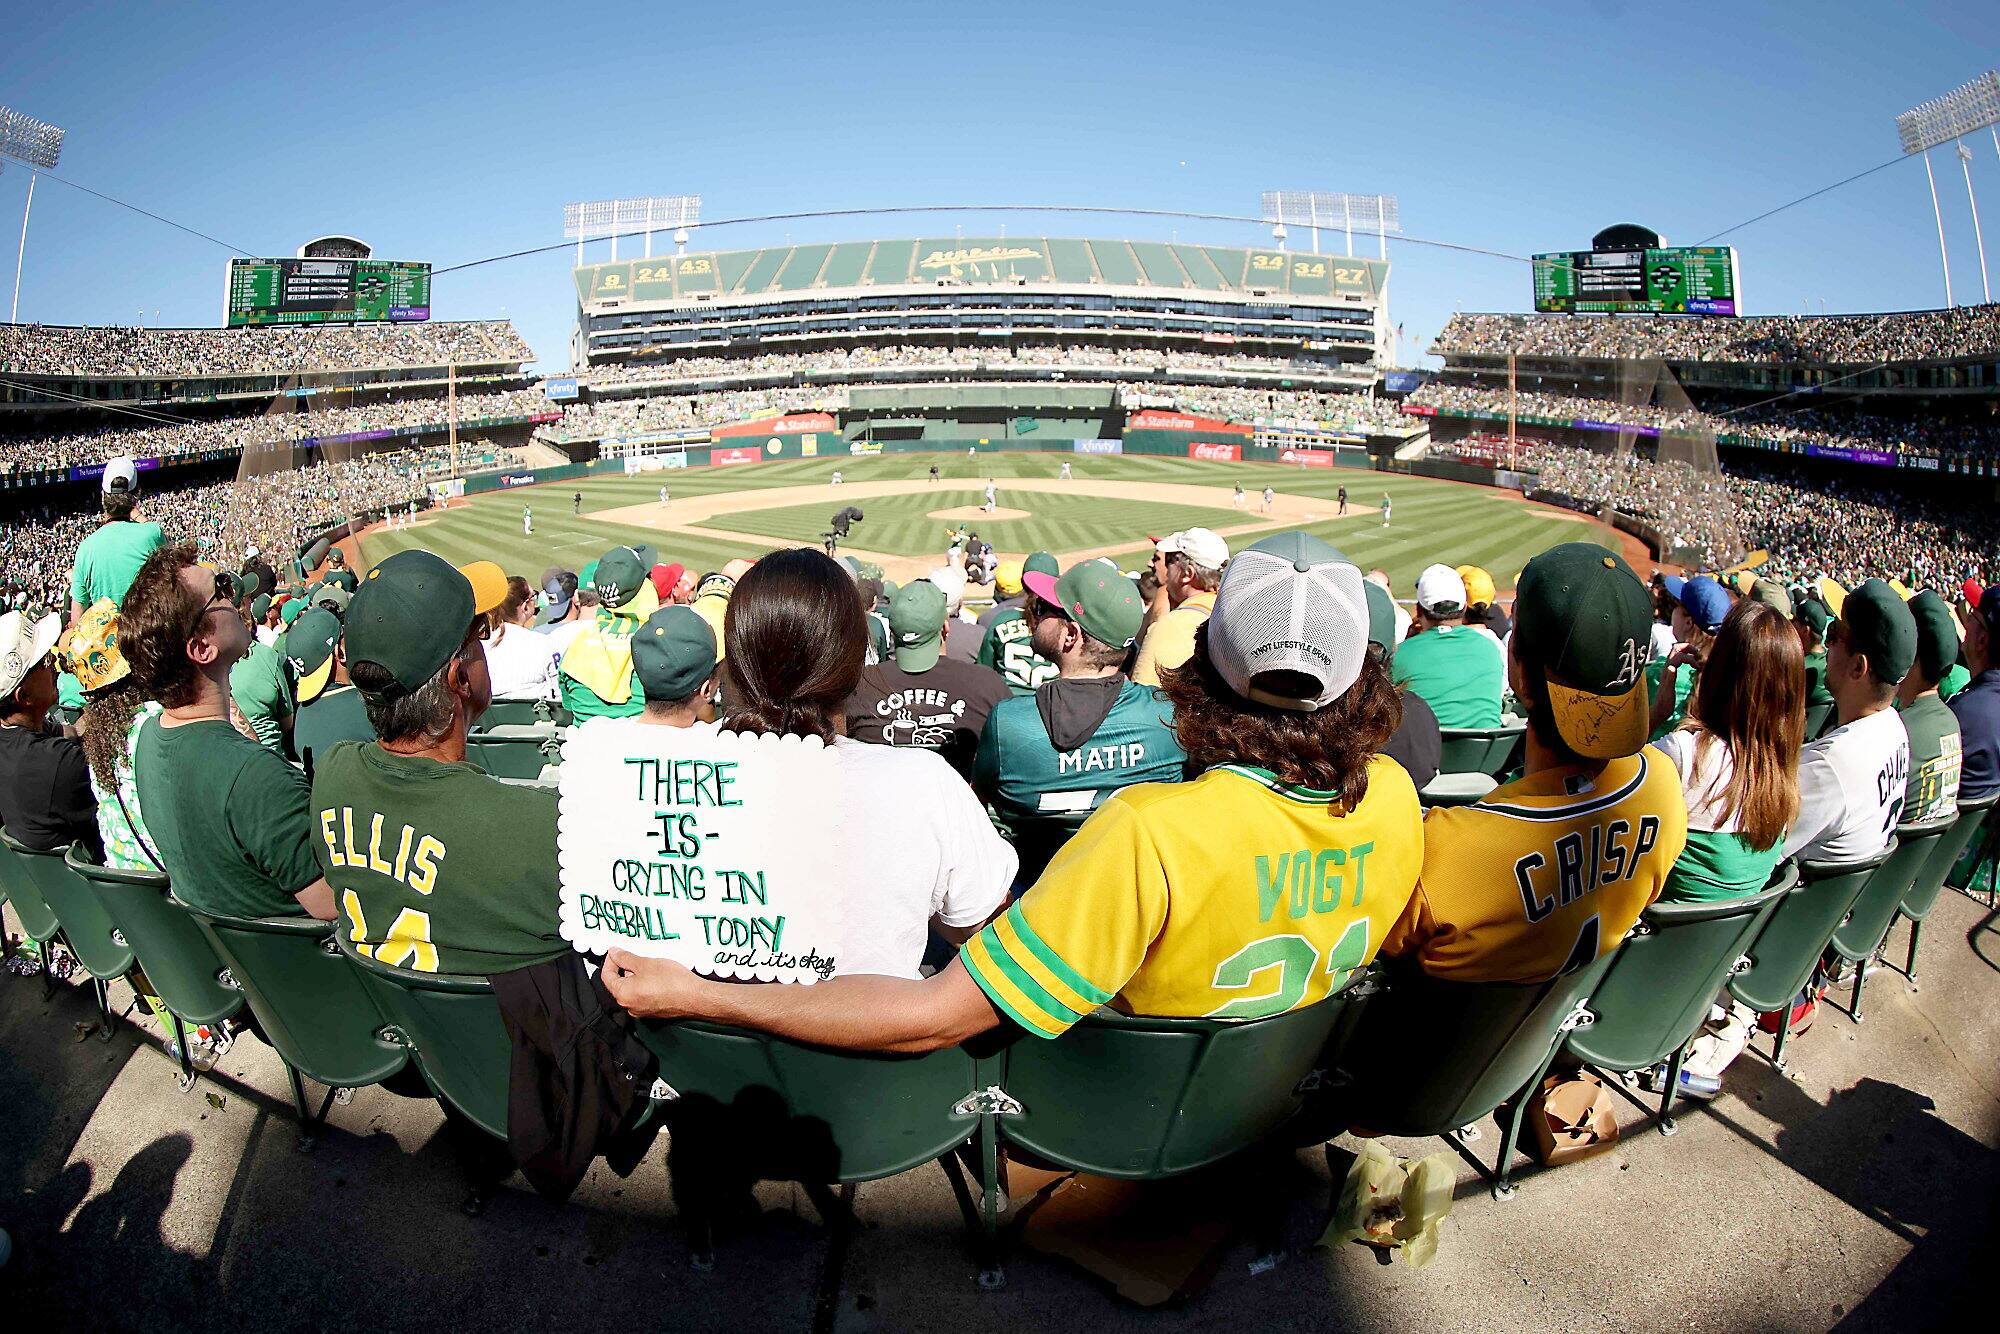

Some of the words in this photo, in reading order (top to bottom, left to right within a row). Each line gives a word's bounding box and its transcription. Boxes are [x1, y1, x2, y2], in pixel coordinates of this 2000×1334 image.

[638, 267, 670, 280] 24
[680, 259, 711, 271] 43
[1253, 255, 1284, 267] 34
[1294, 262, 1326, 275] 34
[1334, 268, 1366, 280] 27
[548, 382, 576, 397] xfinity
[1081, 440, 1116, 453] xfinity
[509, 474, 535, 485] Fanatics
[1273, 640, 1313, 653] LIFESTYLE
[1312, 646, 1333, 666] BRAND
[1605, 638, 1647, 688] A's
[876, 688, 949, 716] COFFEE
[950, 699, 967, 718] &
[1058, 743, 1146, 775] MATIP
[623, 757, 744, 808] THERE
[320, 806, 447, 896] ELLIS
[612, 858, 706, 901] CRYING
[715, 870, 769, 906] IN
[1254, 841, 1376, 924] VOGT
[1513, 814, 1661, 924] CRISP
[579, 892, 681, 941] BASEBALL
[694, 914, 786, 953] TODAY
[714, 948, 757, 968] and
[761, 951, 797, 970] it's
[799, 946, 836, 980] okay
